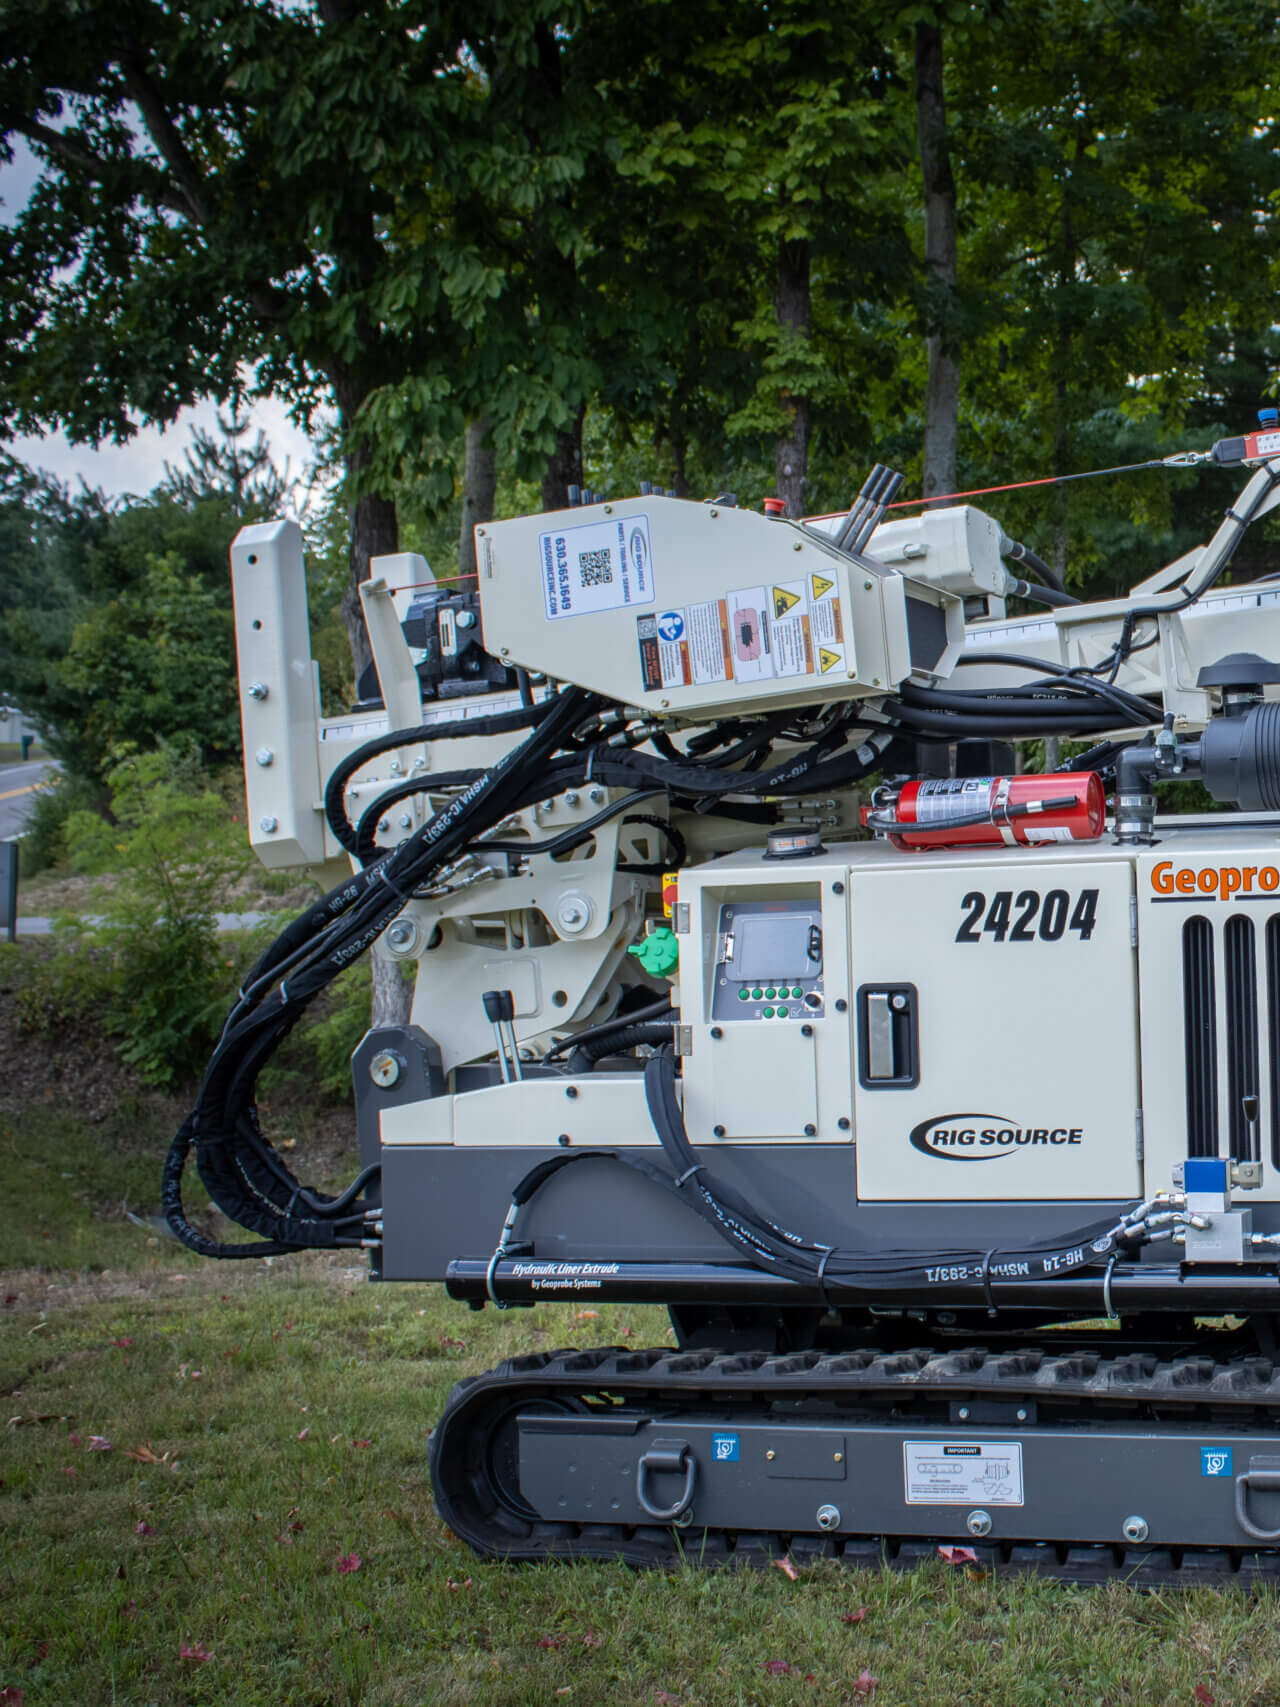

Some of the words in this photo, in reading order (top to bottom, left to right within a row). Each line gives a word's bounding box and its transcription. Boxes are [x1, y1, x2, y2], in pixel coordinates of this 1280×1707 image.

[556, 538, 571, 610] 630.365.1649
[459, 773, 490, 805] MSHA
[422, 799, 463, 845] IC-293/1
[955, 889, 1099, 942] 24204
[932, 1129, 976, 1145] RIG
[979, 1128, 1083, 1145] SOURCE
[512, 1264, 556, 1277] Hydraulic
[557, 1264, 581, 1274] Liner
[582, 1263, 619, 1274] Extrude
[1042, 1248, 1083, 1272] HG-14
[531, 1280, 540, 1290] by
[541, 1280, 574, 1290] Geoprobe
[574, 1279, 601, 1290] Systems
[925, 1266, 984, 1282] C-293/1
